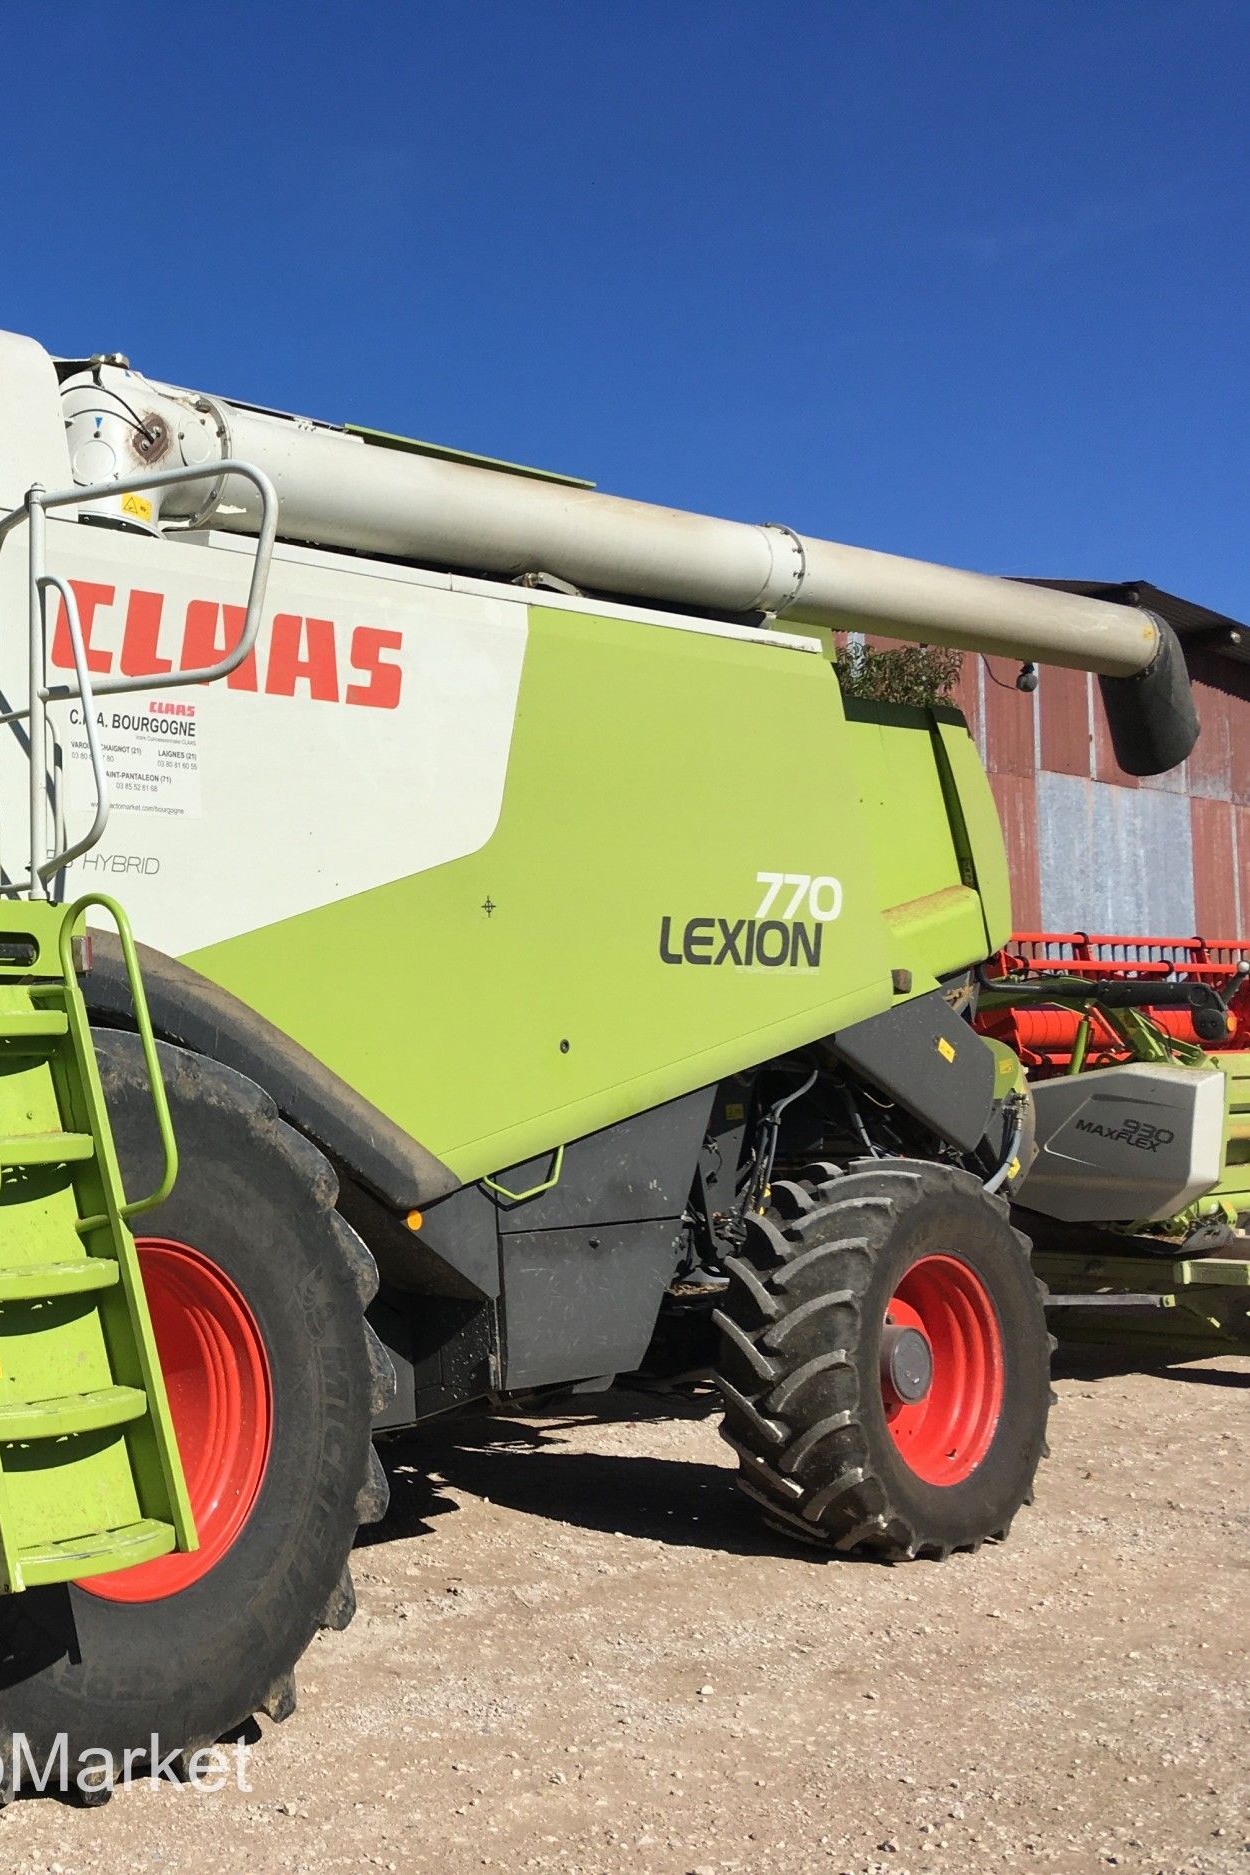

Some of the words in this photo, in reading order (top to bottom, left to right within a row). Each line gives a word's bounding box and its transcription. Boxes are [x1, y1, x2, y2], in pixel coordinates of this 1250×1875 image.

[51, 578, 402, 710] CLAAS
[149, 701, 196, 717] CLAAS
[112, 714, 196, 737] BOURGOGNE
[158, 750, 185, 759] LAIGNES
[106, 770, 159, 782] AINT-PANTALEON
[82, 853, 161, 876] HYBRID
[754, 871, 843, 922] 770
[659, 915, 823, 968] LEXION
[1075, 1119, 1160, 1153] MAXFLEX
[1122, 1118, 1175, 1145] 930
